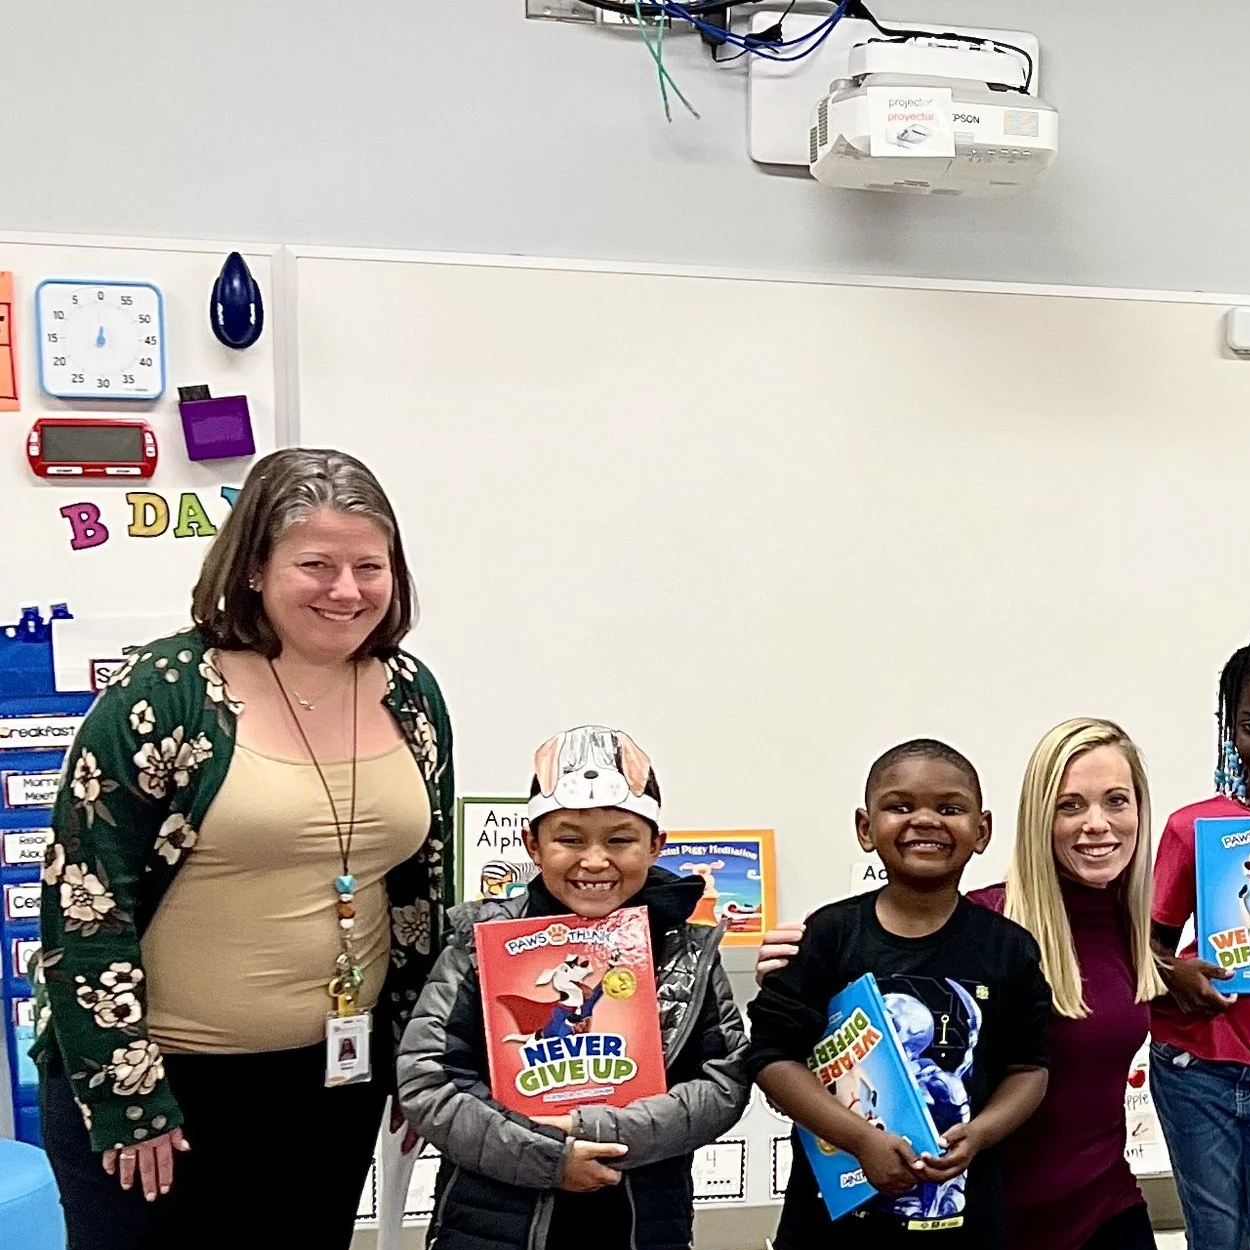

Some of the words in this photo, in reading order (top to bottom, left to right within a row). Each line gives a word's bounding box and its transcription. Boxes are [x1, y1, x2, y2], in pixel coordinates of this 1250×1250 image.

[887, 112, 935, 123] proyector
[71, 295, 79, 305] 5
[97, 291, 105, 302] 0
[120, 295, 133, 306] 55
[53, 310, 65, 321] 10
[138, 314, 151, 325] 50
[47, 333, 58, 344] 15
[144, 335, 157, 346] 45
[52, 356, 66, 367] 20
[139, 357, 153, 368] 40
[71, 373, 85, 384] 25
[96, 378, 110, 389] 30
[121, 374, 135, 385] 35
[9, 726, 75, 738] reakfast
[477, 830, 522, 854] Alph
[508, 932, 547, 951] PAWS
[1212, 929, 1248, 950] WE
[523, 1034, 622, 1067] NEVER
[518, 1060, 588, 1092] GIVE
[592, 1057, 635, 1082] UP
